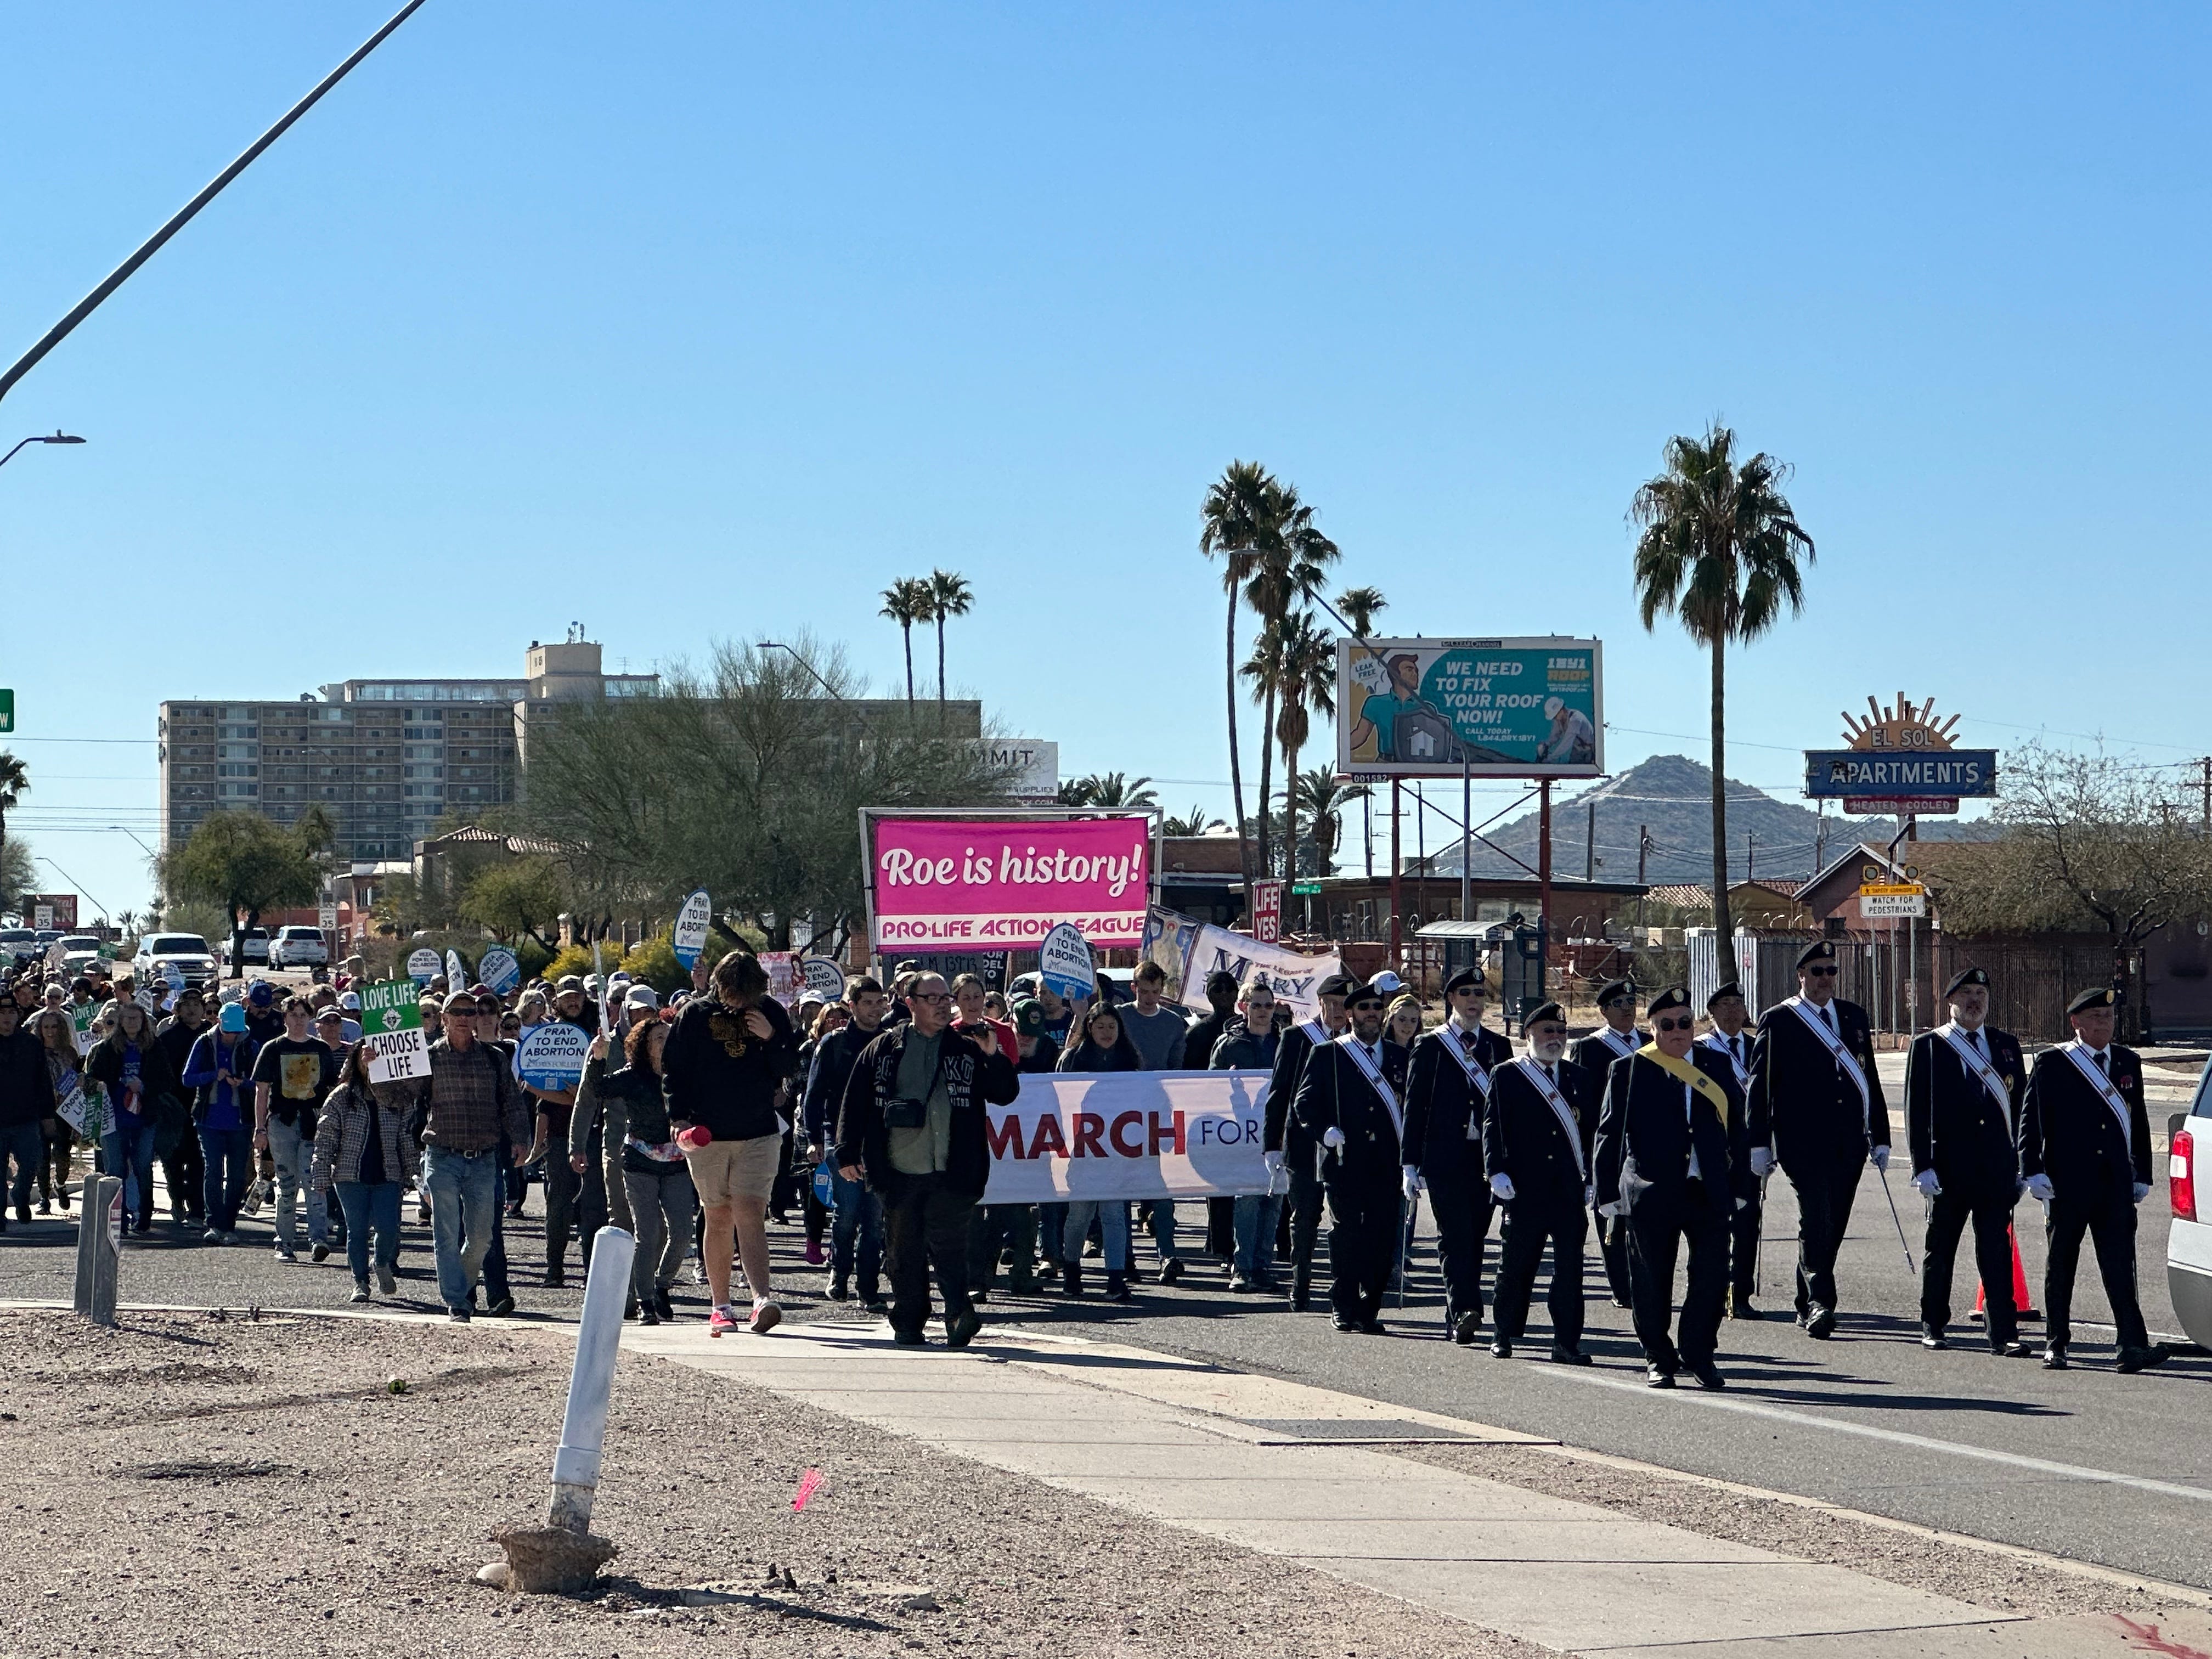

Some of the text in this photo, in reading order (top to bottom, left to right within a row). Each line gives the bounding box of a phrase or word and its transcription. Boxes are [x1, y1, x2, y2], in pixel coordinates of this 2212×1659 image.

[1355, 662, 1374, 672] LEAK
[1358, 669, 1376, 678] FREE
[1446, 662, 1523, 676] WE NEED
[1435, 678, 1492, 691] TO FIX
[1443, 693, 1544, 708] YOUR ROOF
[1456, 710, 1503, 724] NOW!
[1871, 729, 1935, 747] EL SOL
[1354, 774, 1388, 783] 001582
[1830, 761, 1980, 784] APARTMENTS
[1851, 800, 1950, 810] HEATED COOLED
[881, 843, 1143, 898] Roe is history!
[1255, 886, 1278, 912] LIFE
[688, 909, 698, 919] TO
[1869, 906, 1917, 915] PEDESTRIANS
[38, 918, 50, 927] 35
[322, 919, 334, 928] 35
[979, 918, 1054, 936] ACTION
[1074, 916, 1146, 934] EAGUE
[1256, 915, 1276, 941] YES
[1062, 928, 1081, 944] PRAY
[1056, 937, 1085, 957] TO END
[1047, 947, 1091, 972] ABORTION
[812, 972, 830, 981] END
[805, 978, 838, 990] ORTION
[363, 983, 416, 1011] LOVE LIFE
[72, 1006, 91, 1020] LOVE
[372, 1030, 420, 1057] CHOOSE
[535, 1037, 578, 1046] TO END
[525, 1047, 585, 1057] ABORTION
[386, 1055, 413, 1079] LIFE
[61, 1089, 82, 1114] Choos
[986, 1110, 1260, 1160] MARCH FOR
